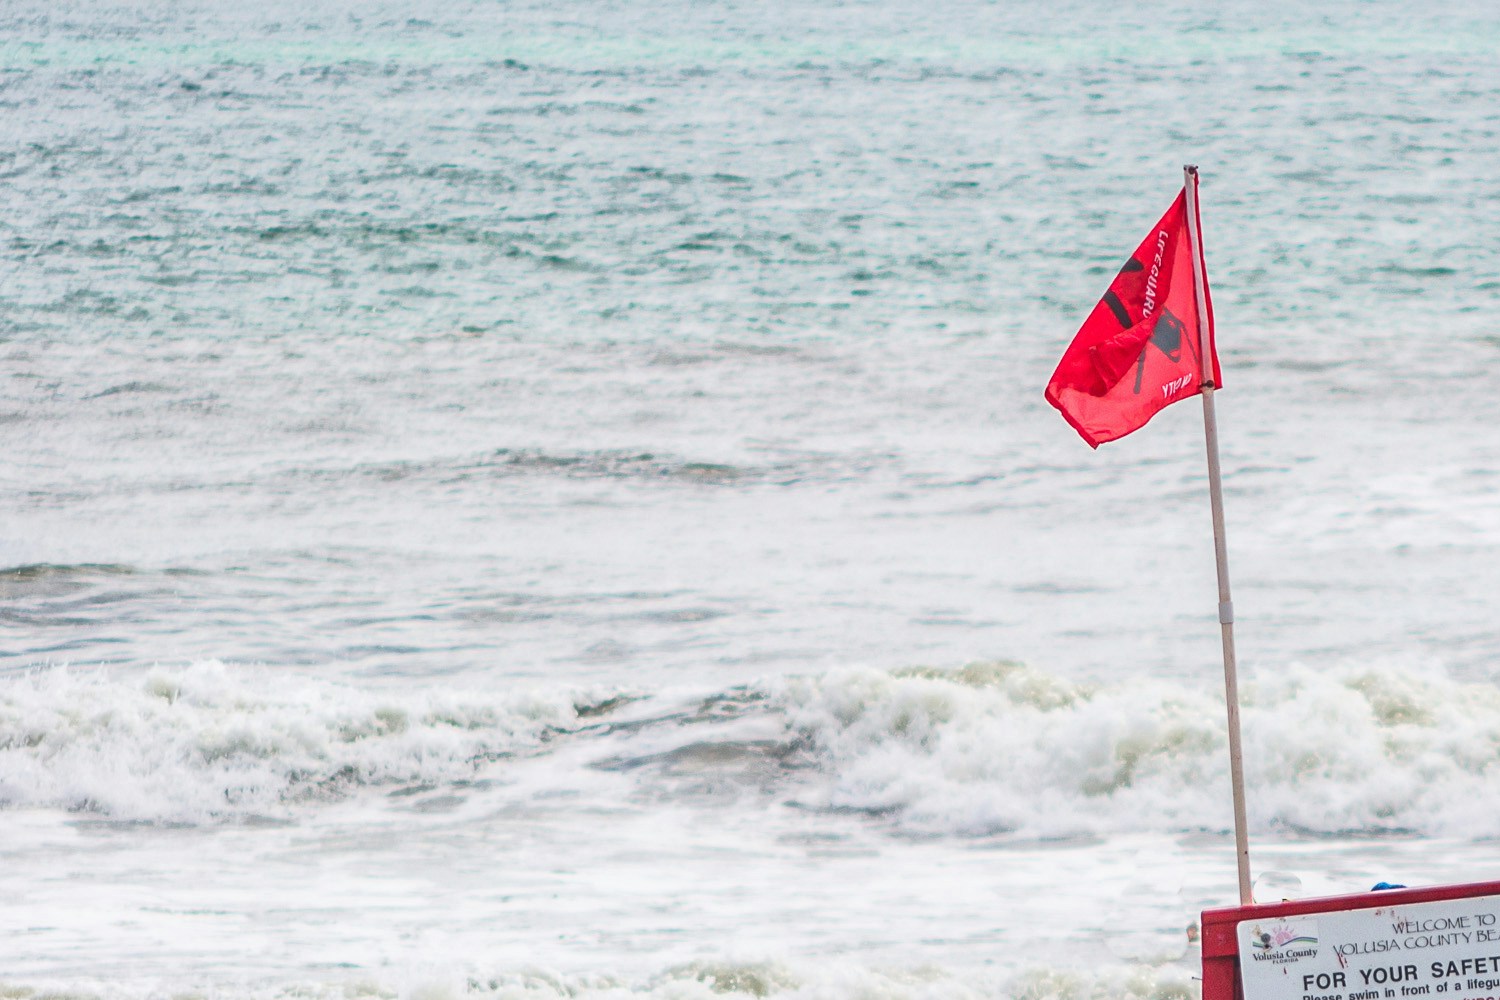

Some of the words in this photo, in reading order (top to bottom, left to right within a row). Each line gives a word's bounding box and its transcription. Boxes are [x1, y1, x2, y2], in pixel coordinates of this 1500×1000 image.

[1392, 916, 1471, 934] WELCOME
[1475, 914, 1496, 926] TO
[1332, 938, 1400, 956] VOLUSIA
[1404, 932, 1472, 950] COUNTY
[1252, 950, 1284, 962] Volusia
[1286, 948, 1318, 959] County
[1303, 972, 1346, 991] FOR
[1360, 965, 1418, 985] YOUR
[1385, 988, 1395, 998] in
[1401, 983, 1430, 996] front
[1436, 982, 1448, 992] of
[1455, 982, 1462, 990] a
